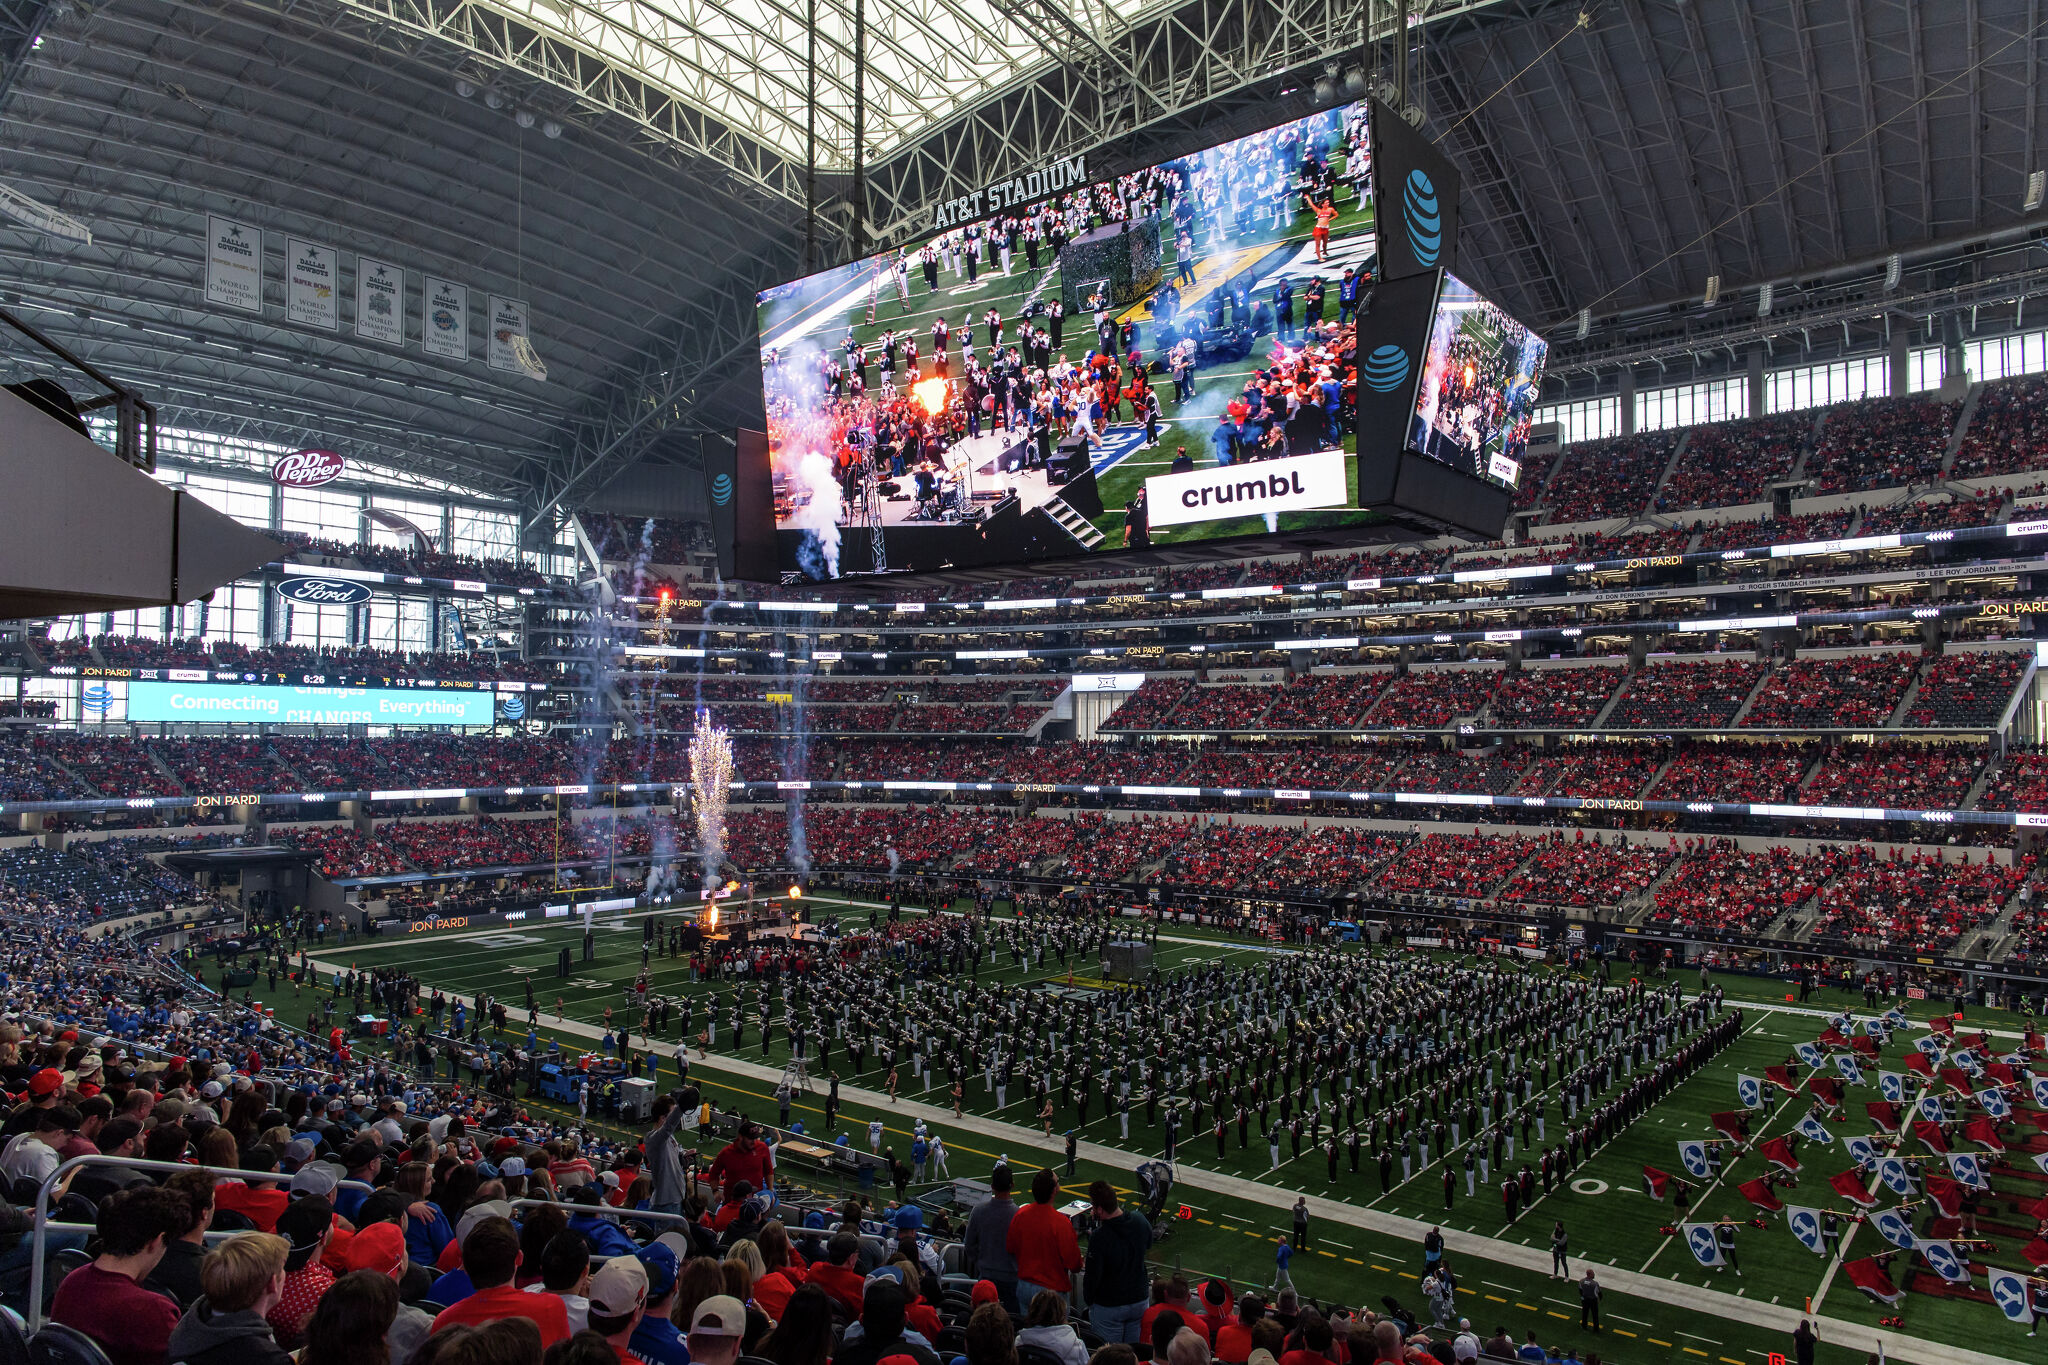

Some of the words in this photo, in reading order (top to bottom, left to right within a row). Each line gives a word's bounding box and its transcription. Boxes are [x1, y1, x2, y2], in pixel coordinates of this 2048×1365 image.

[935, 190, 982, 229] AT&T
[988, 156, 1087, 212] STADIUM
[221, 236, 249, 249] DALLAS
[218, 243, 252, 256] COWBOYS
[300, 258, 325, 269] DALLAS
[296, 264, 328, 277] COWBOYS
[220, 278, 249, 291] WORLD
[293, 277, 312, 287] SUPER
[314, 282, 331, 290] BOWL
[369, 276, 393, 287] DALLAS
[210, 284, 258, 300] CHAMPIONS
[366, 282, 395, 294] COWBOYS
[226, 295, 242, 304] 1971
[300, 298, 326, 310] WORLD
[435, 294, 457, 304] DALLAS
[291, 304, 334, 319] CHAMPIONS
[433, 300, 459, 311] COWBOYS
[305, 315, 320, 323] 1977
[368, 314, 392, 325] WORLD
[496, 318, 521, 327] COWBOYS
[498, 312, 518, 321] DALLAS
[360, 320, 400, 335] CHAMPIONS
[373, 330, 387, 339] 1992
[434, 331, 457, 342] WORLD
[427, 337, 464, 351] CHAMPIONS
[304, 453, 330, 468] Dr
[276, 454, 341, 483] Pepper
[1495, 460, 1511, 476] crumbl
[1182, 471, 1305, 507] crumbl
[1625, 559, 1648, 569] JON
[1651, 555, 1682, 566] PARDI
[295, 580, 356, 601] Ford
[1979, 604, 2009, 615] JON
[82, 667, 102, 676] JON
[105, 668, 132, 677] PARDI
[303, 675, 325, 684] 6:26
[170, 694, 279, 713] Connecting
[1014, 784, 1030, 792] JON
[1032, 784, 1056, 793] PARDI
[193, 795, 220, 807] JON
[225, 795, 261, 805] PARDI
[1579, 799, 1604, 809] JON
[1608, 800, 1643, 810] PARDI
[408, 922, 433, 933] JON
[436, 917, 468, 929] PARDI
[1908, 988, 1923, 998] NOISE
[1179, 1207, 1191, 1218] 20
